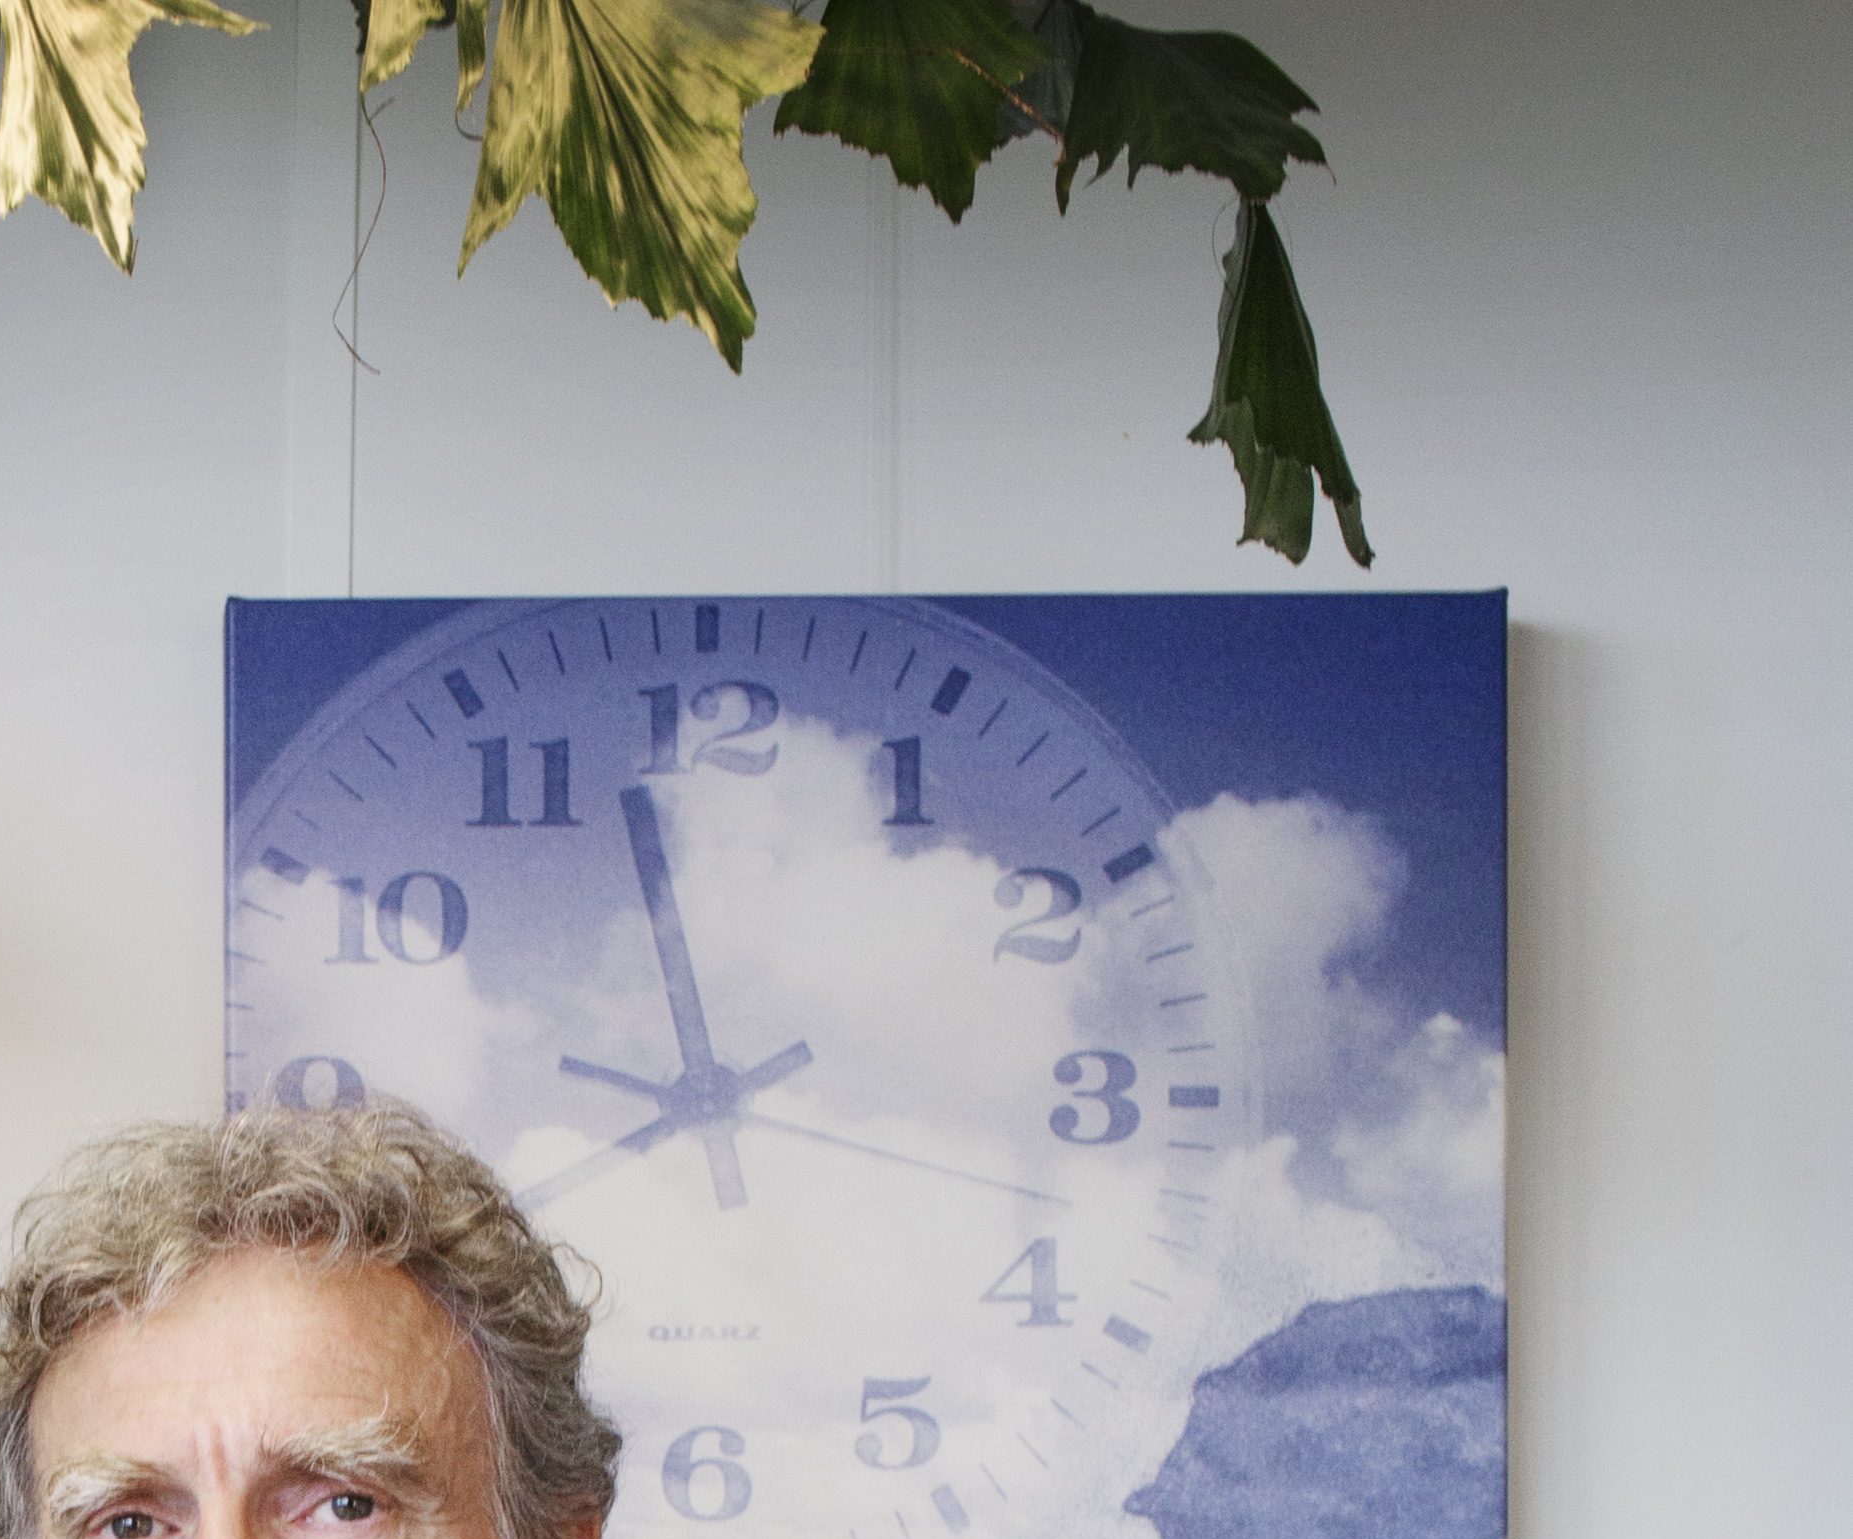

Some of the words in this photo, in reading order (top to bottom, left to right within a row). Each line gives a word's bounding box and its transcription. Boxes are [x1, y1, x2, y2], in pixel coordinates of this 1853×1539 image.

[637, 680, 781, 776] 12
[465, 736, 584, 829] 11
[881, 735, 936, 826] 1
[323, 870, 470, 965] 10
[992, 866, 1083, 965] 2
[1048, 1049, 1141, 1145] 3
[977, 1235, 1079, 1328] 4
[647, 1324, 761, 1342] QUARZ
[853, 1375, 943, 1471] 5
[661, 1425, 753, 1522] 6
